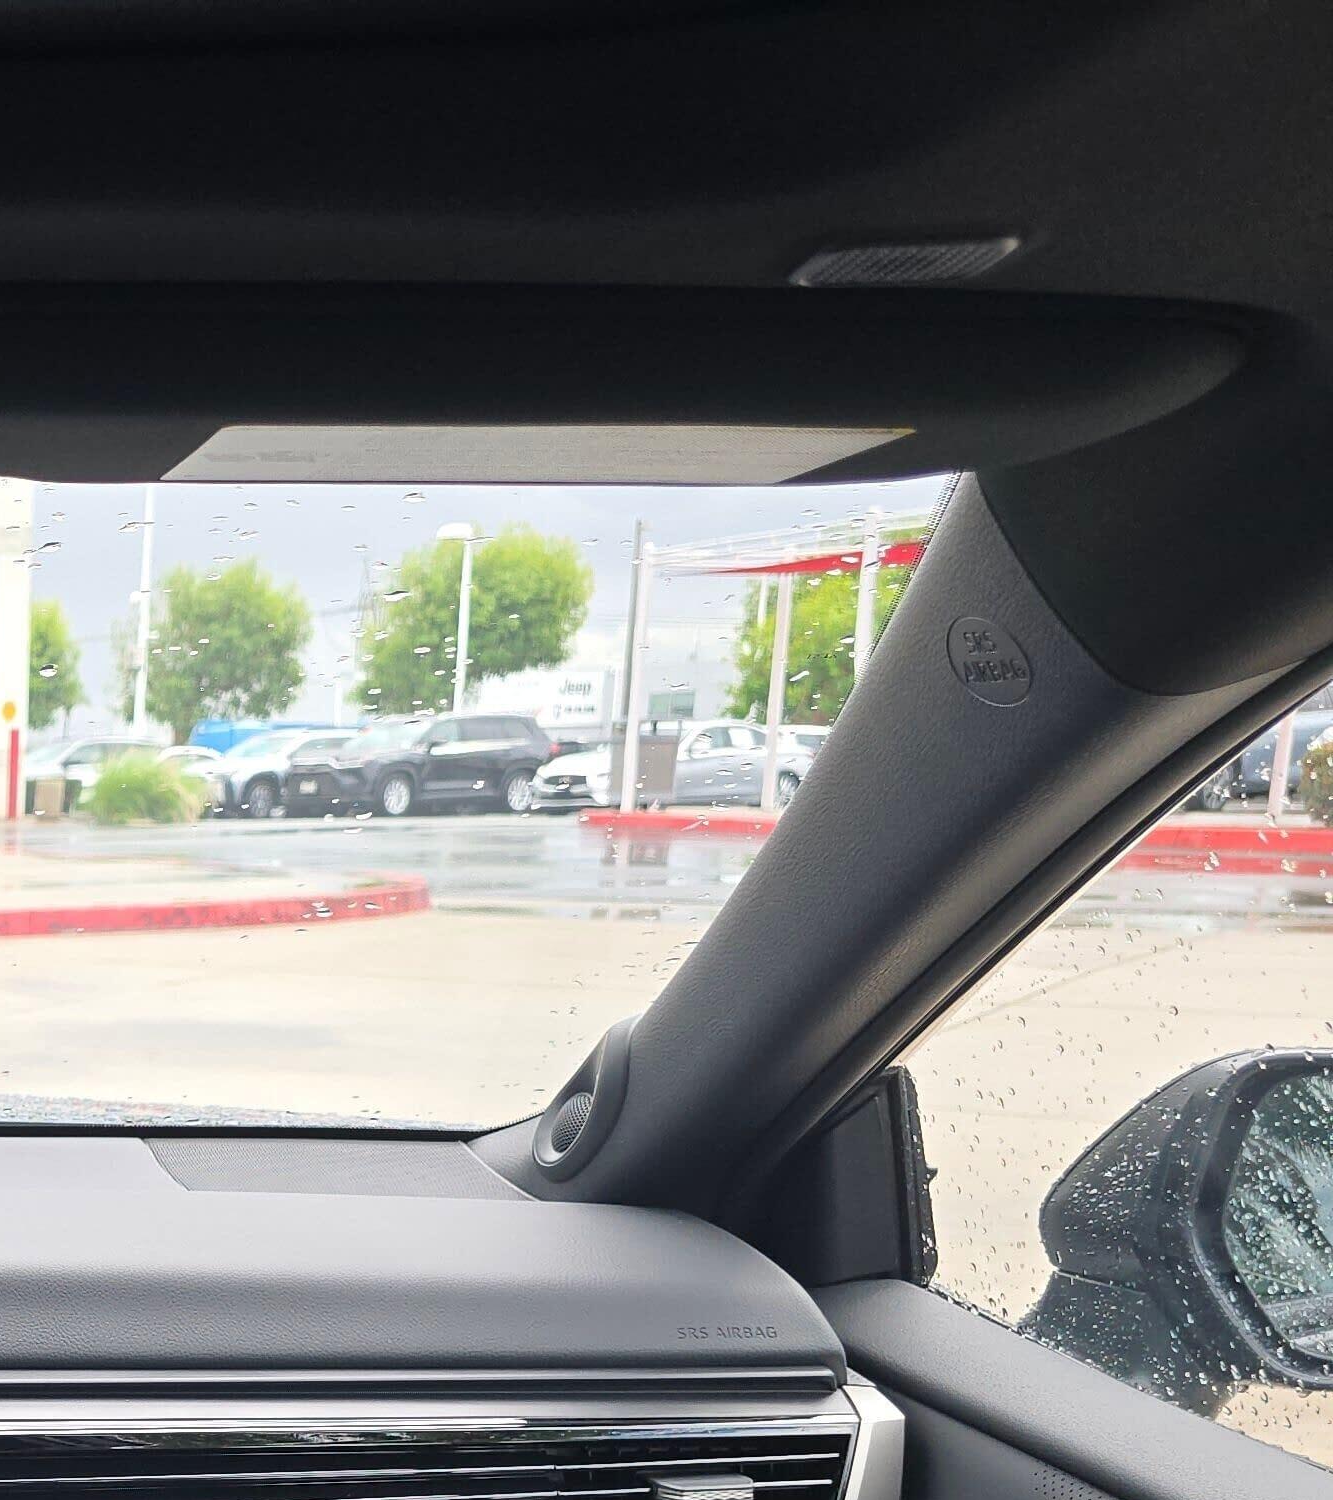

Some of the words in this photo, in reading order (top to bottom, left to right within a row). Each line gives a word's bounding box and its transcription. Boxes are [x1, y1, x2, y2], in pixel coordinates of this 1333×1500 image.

[963, 631, 997, 655] SRS
[963, 659, 1027, 683] AIRBAG
[677, 1327, 709, 1339] SRS
[717, 1326, 778, 1339] AIRBAG
